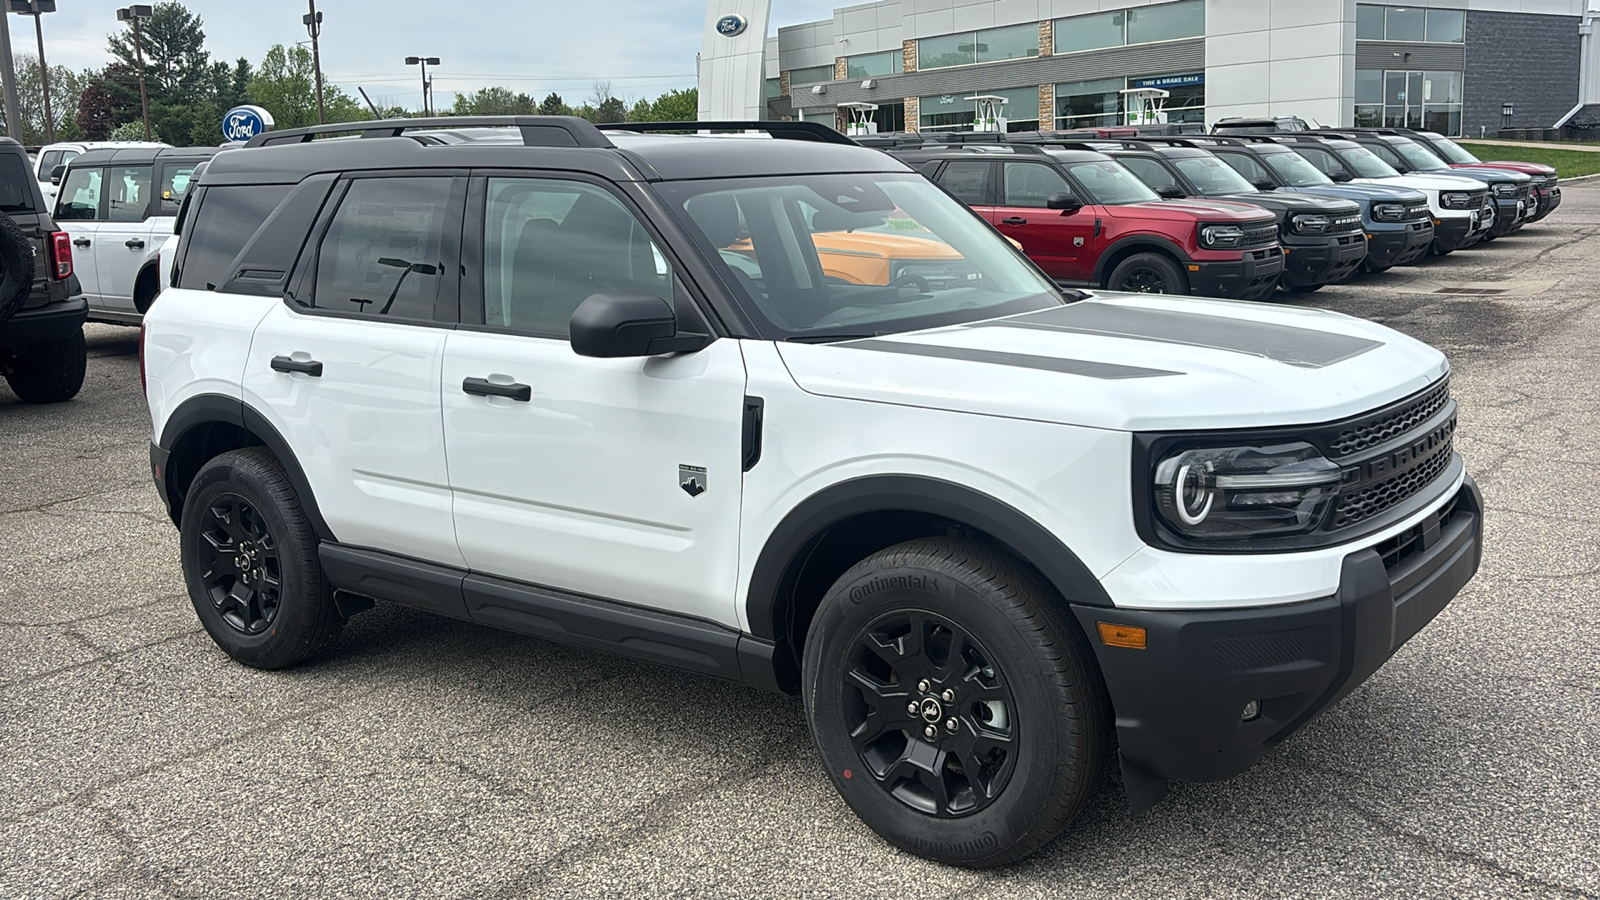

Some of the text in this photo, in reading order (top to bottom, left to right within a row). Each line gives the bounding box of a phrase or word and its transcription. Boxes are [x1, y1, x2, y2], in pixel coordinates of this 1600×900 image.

[721, 19, 737, 32] Ford
[229, 115, 254, 138] Ford
[849, 575, 928, 605] Continental
